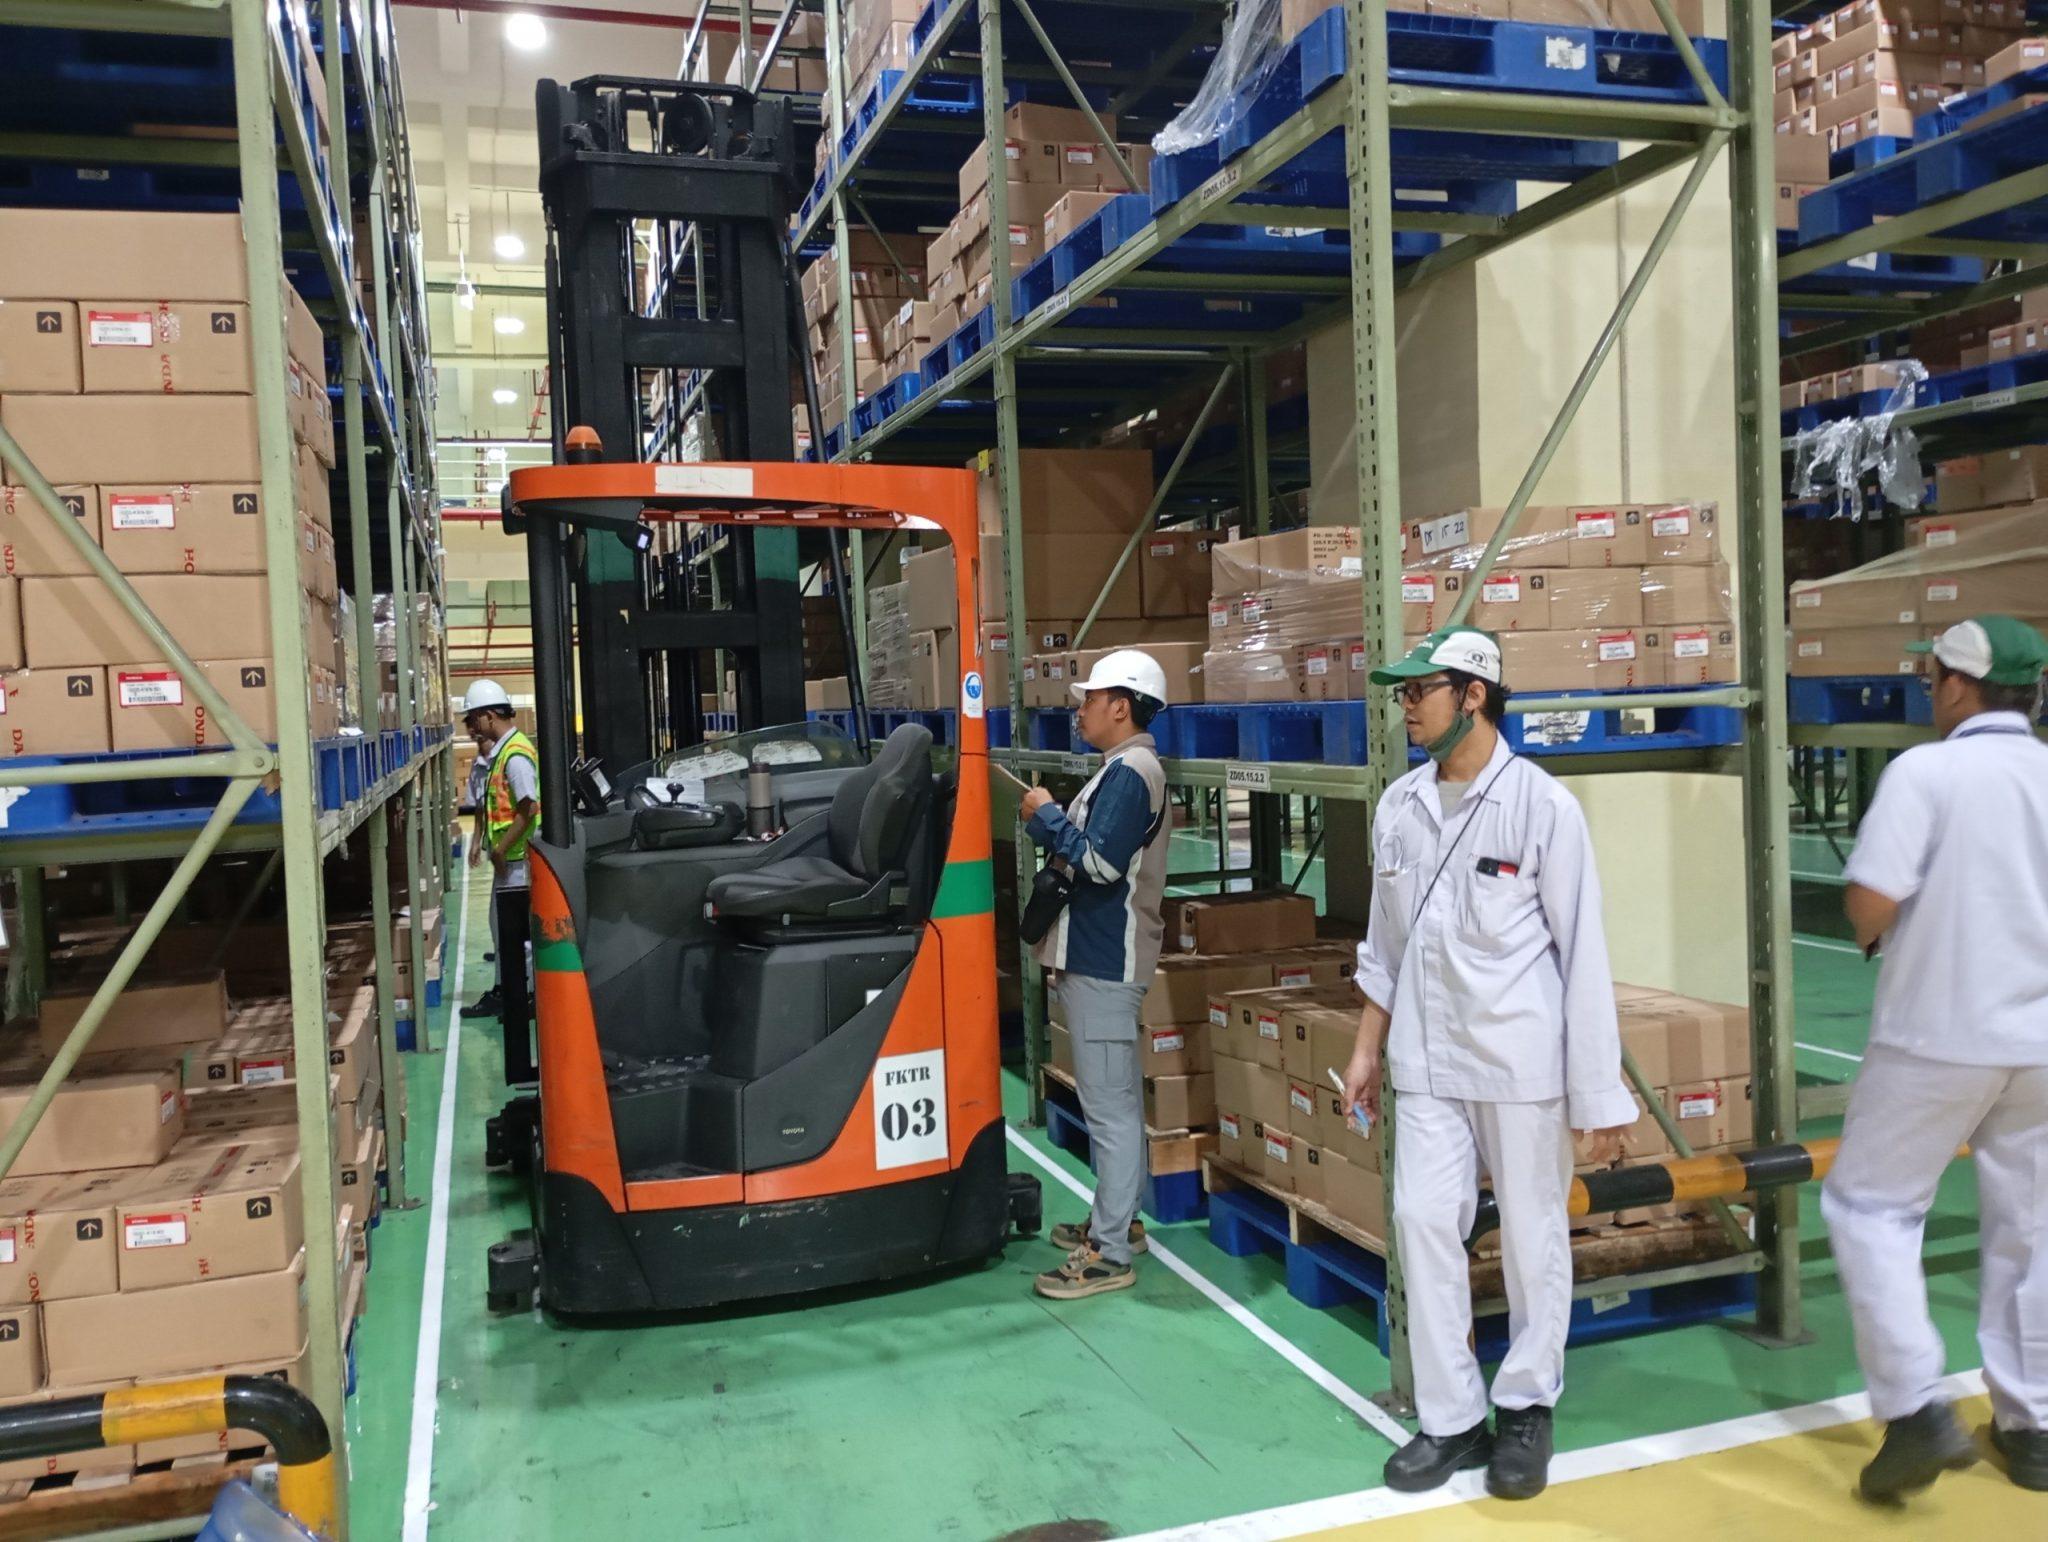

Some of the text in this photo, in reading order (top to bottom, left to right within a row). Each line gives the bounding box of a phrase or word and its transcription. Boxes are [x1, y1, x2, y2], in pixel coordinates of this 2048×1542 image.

[885, 1066, 931, 1086] FKTR
[881, 1097, 937, 1141] 03
[782, 1127, 805, 1136] TOYOTA
